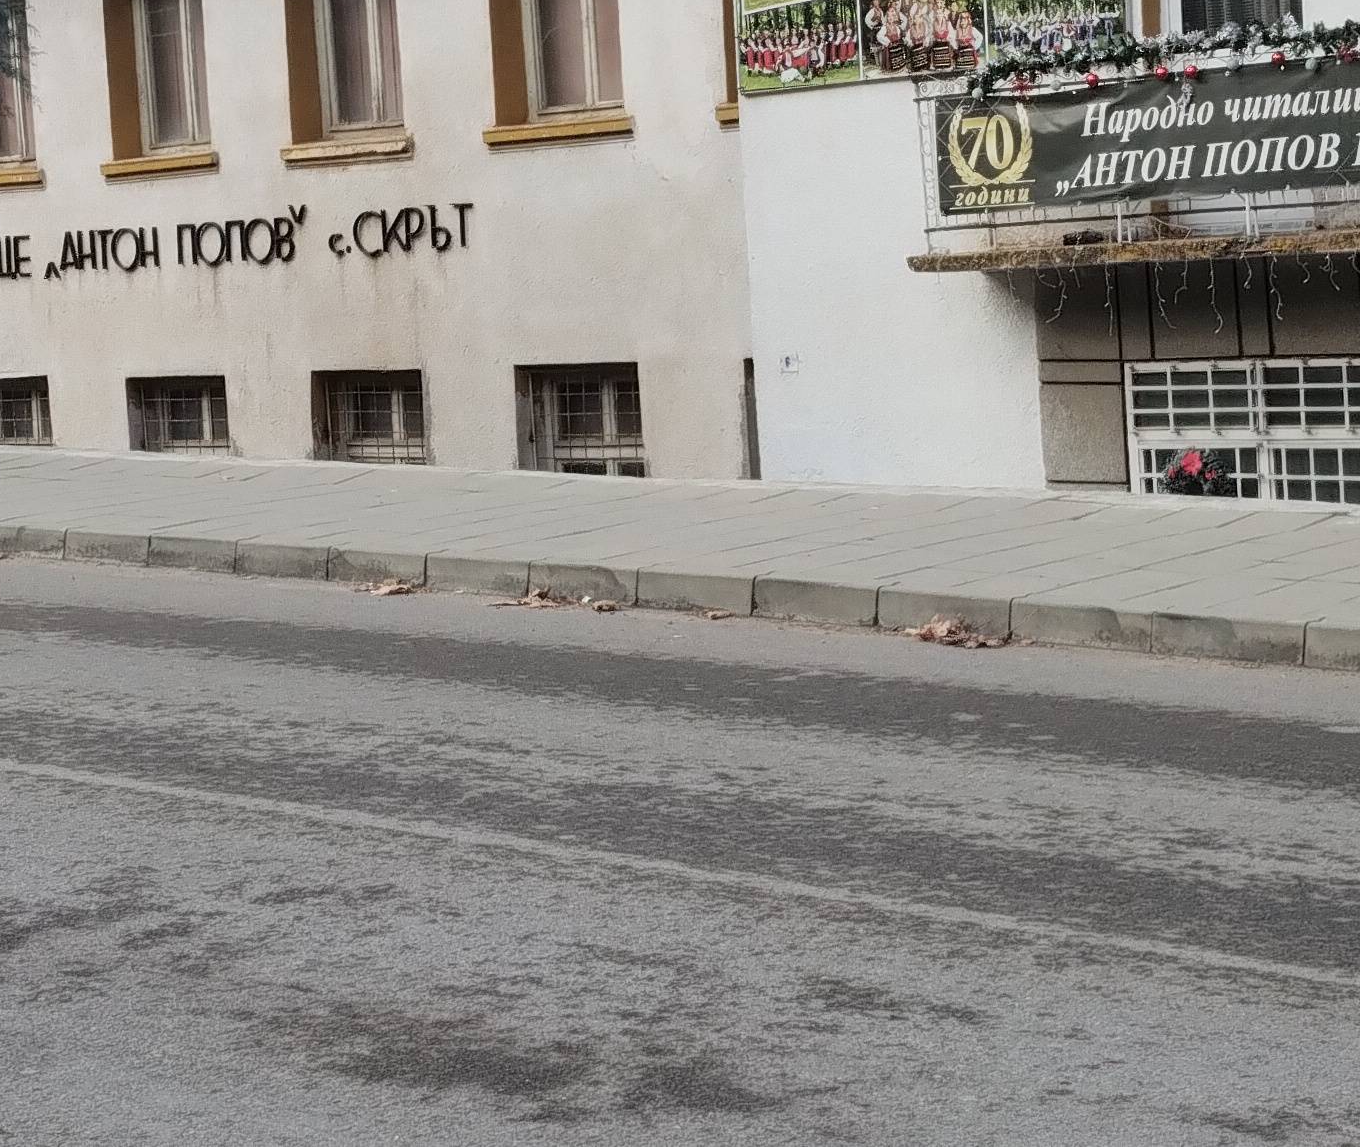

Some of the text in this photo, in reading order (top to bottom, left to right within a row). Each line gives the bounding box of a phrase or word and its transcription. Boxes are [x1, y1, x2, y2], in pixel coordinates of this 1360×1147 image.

[961, 114, 1014, 170] 70
[1080, 94, 1214, 143] Народно
[1054, 145, 1196, 198] „АНТОН
[1200, 132, 1342, 179] ПОПОВ
[954, 186, 1030, 206] години
